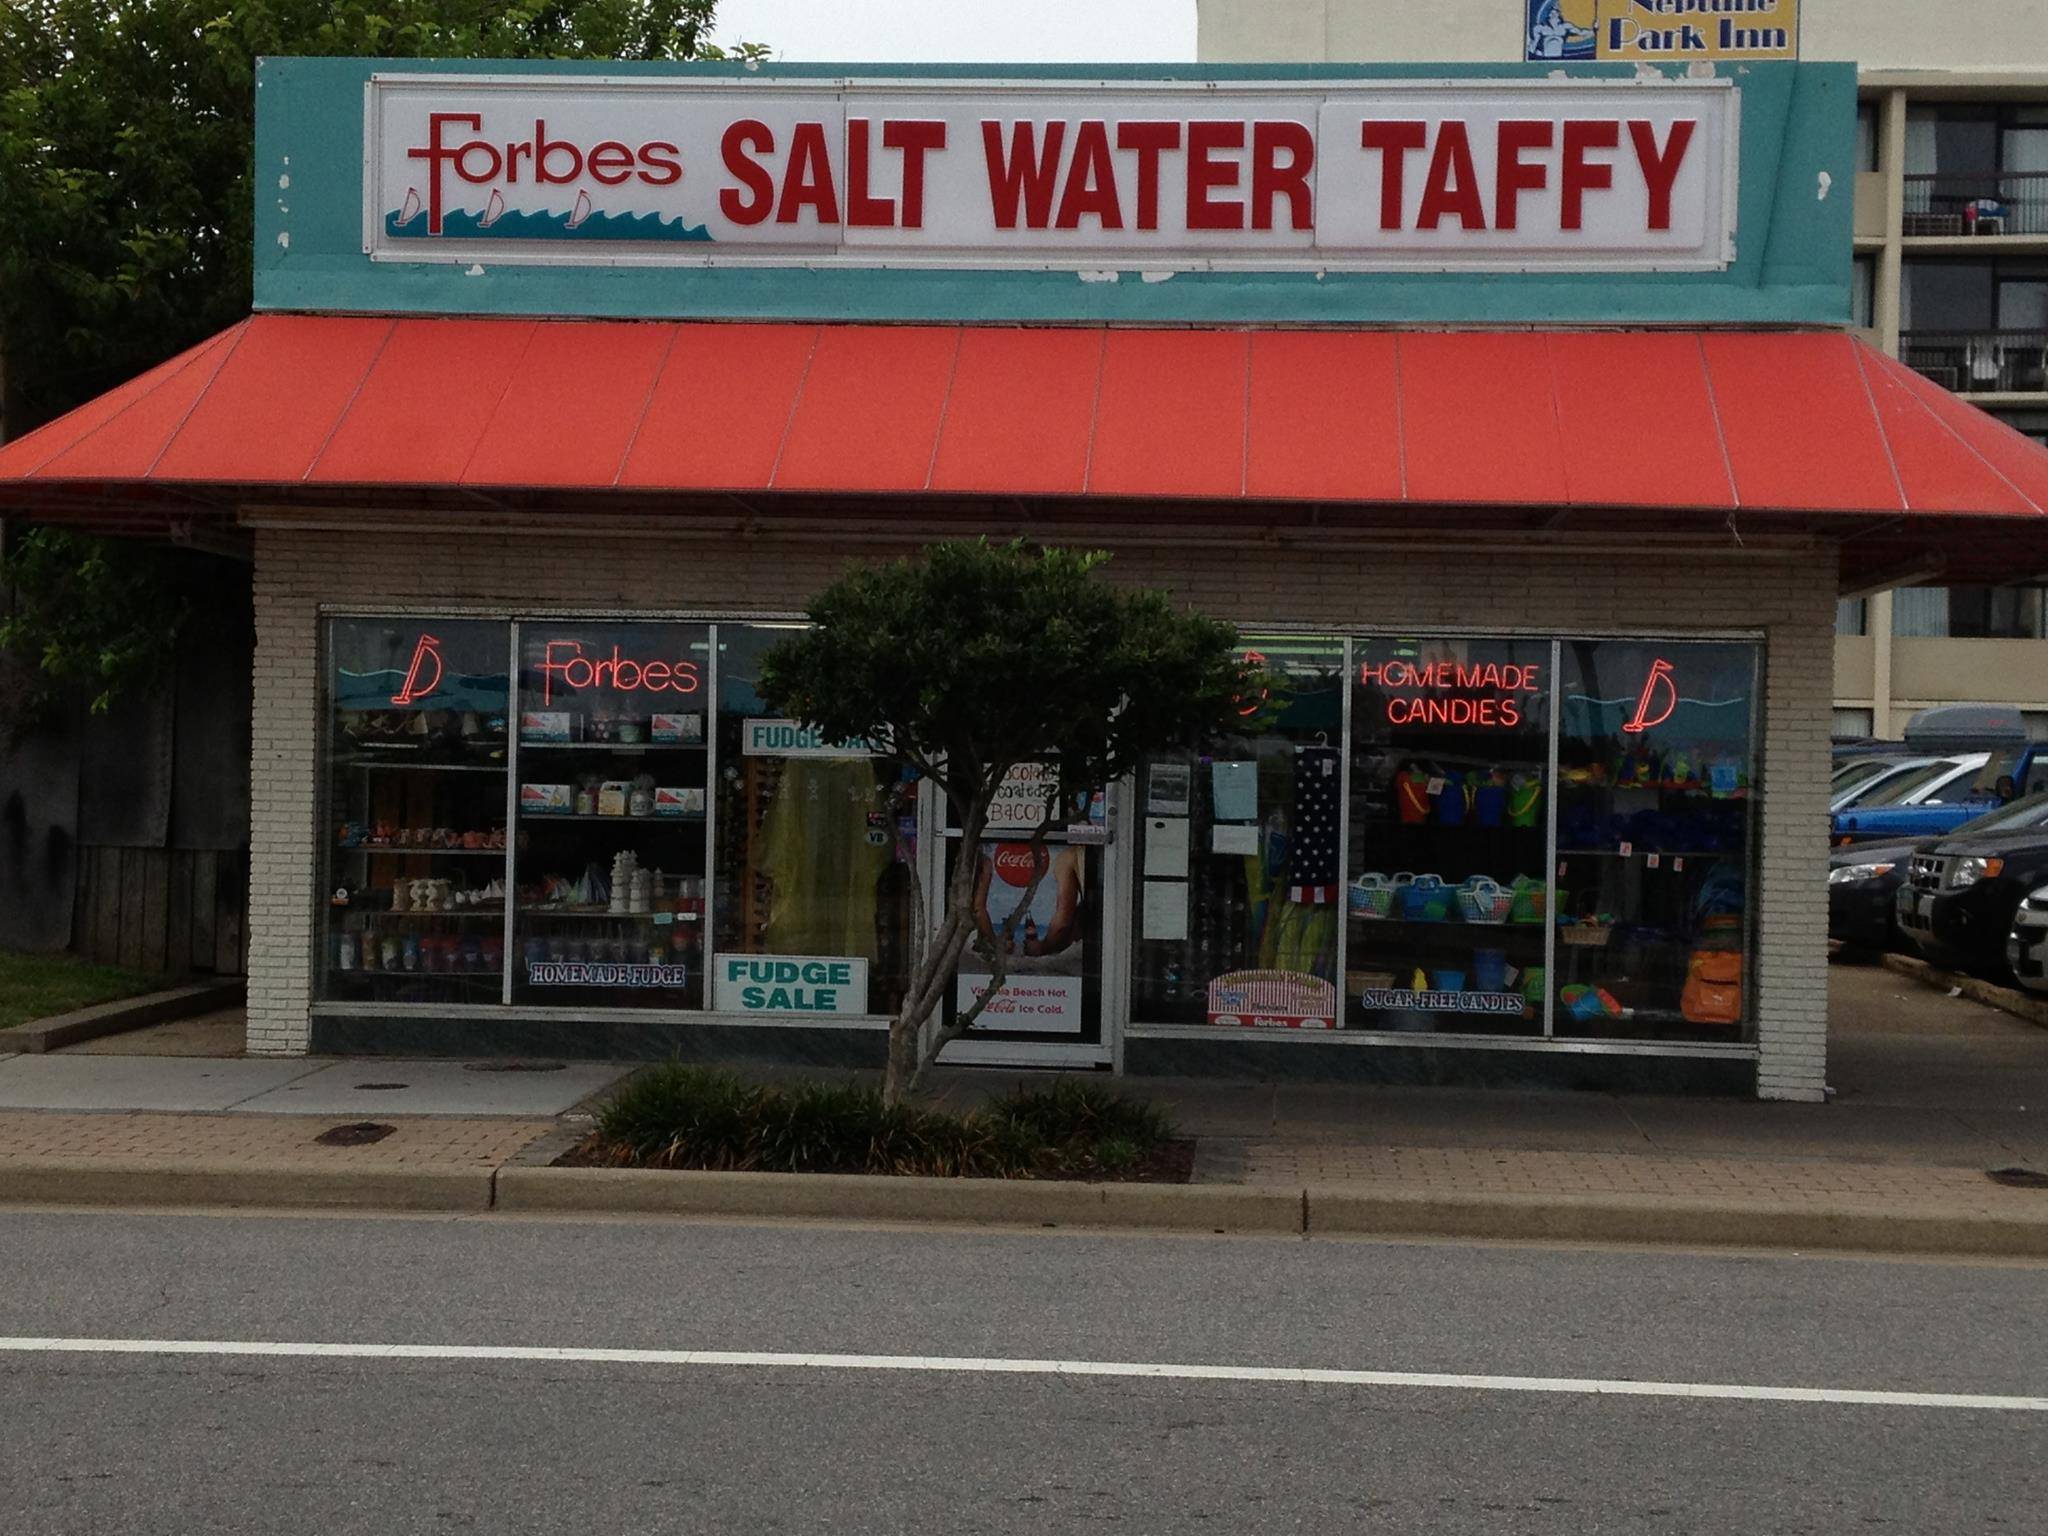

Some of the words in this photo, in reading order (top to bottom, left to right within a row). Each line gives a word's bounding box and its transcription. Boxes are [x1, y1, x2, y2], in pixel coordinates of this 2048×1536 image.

[1609, 17, 1708, 51] Park
[1718, 18, 1787, 50] Inn
[407, 112, 683, 234] Forbes
[719, 119, 947, 228] SALT
[981, 120, 1314, 231] WATER
[1361, 120, 1698, 231] TAFFY
[534, 640, 699, 706] Forbes
[1361, 660, 1540, 692] HOMEMADE
[1387, 698, 1520, 727] CANDIES
[753, 726, 822, 749] FUDGE
[997, 850, 1047, 868] Coca-Co
[531, 963, 628, 984] HOMEMADE
[630, 966, 684, 986] FUDGE
[728, 961, 851, 985] FUDGE
[742, 987, 837, 1010] SALE
[1013, 987, 1045, 997] Beach
[1364, 990, 1458, 1010] SUGAR-FREE
[1459, 993, 1524, 1014] CANDIES
[1019, 1005, 1034, 1013] Ice
